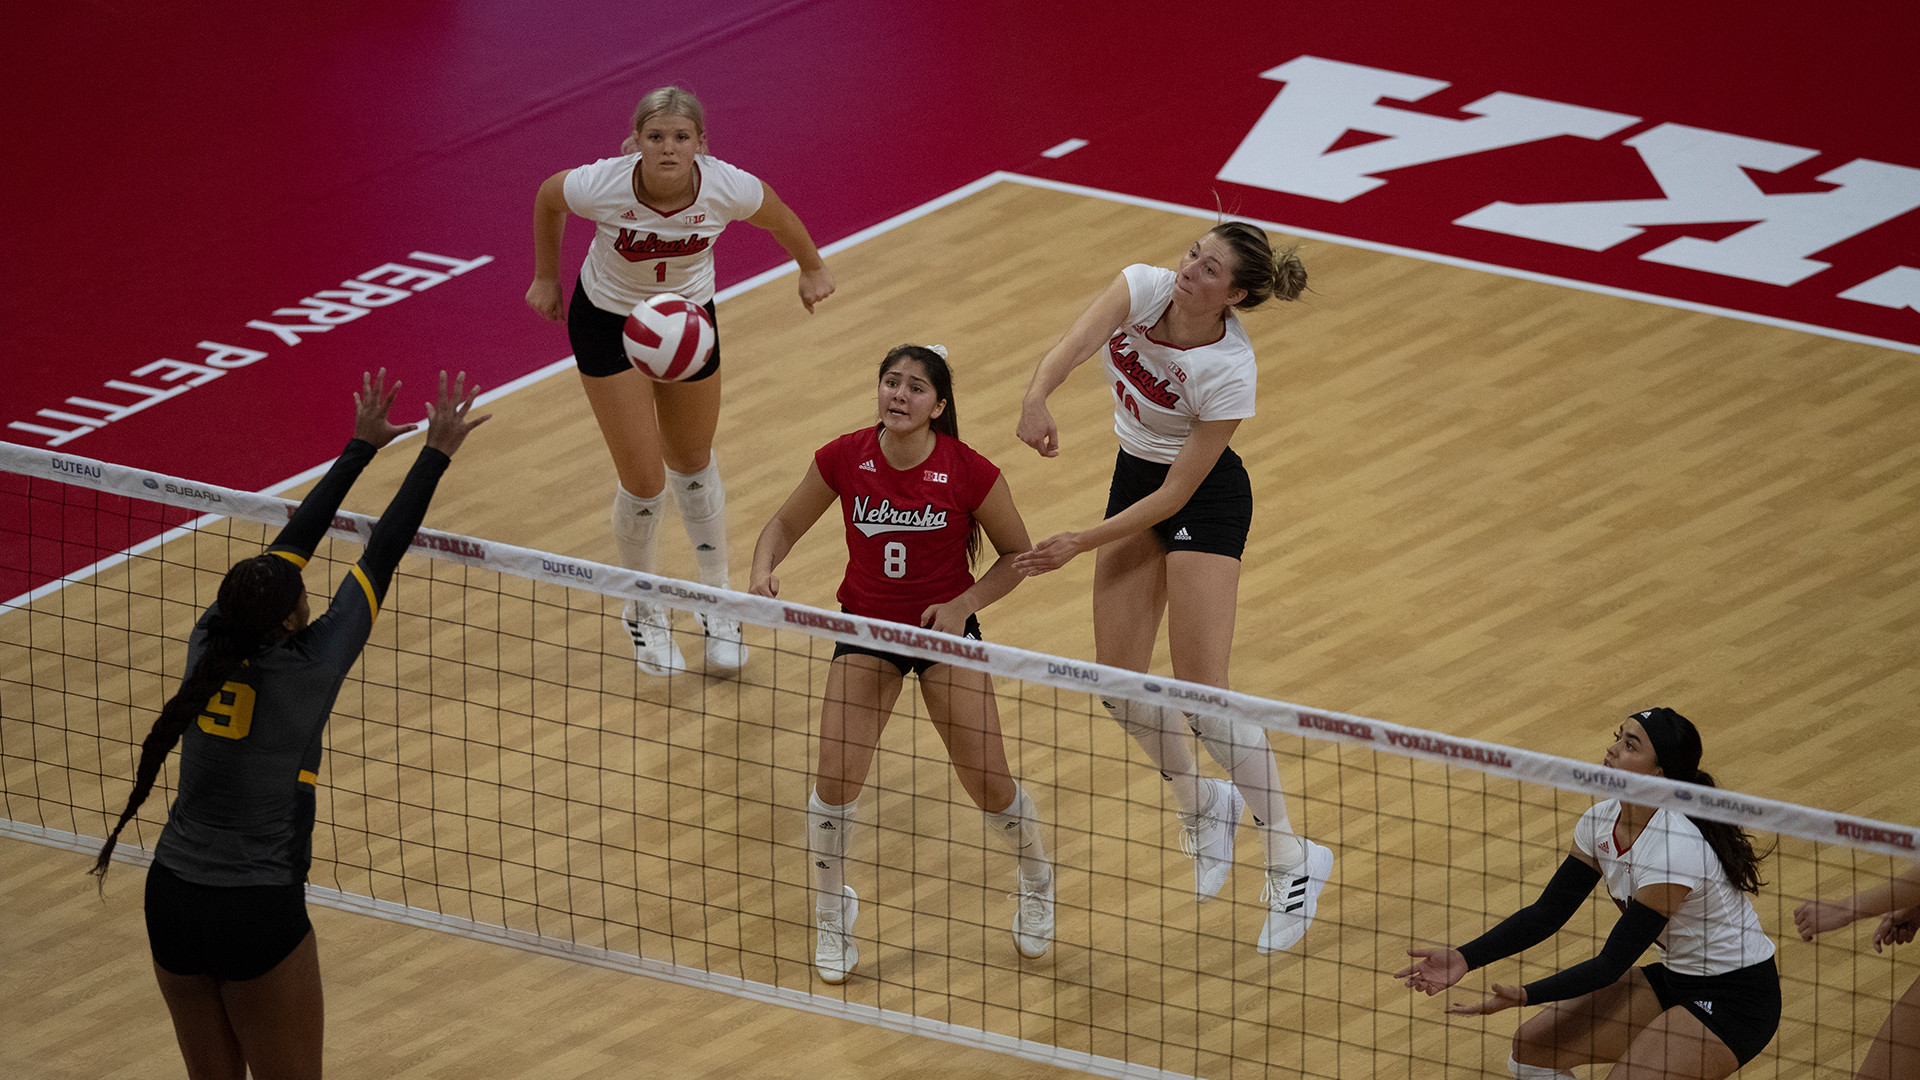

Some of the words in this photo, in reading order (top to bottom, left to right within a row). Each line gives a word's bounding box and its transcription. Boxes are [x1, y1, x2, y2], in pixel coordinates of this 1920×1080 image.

[1215, 54, 1920, 314] KA
[614, 228, 710, 253] Nebraska
[654, 261, 667, 283] 1
[246, 251, 494, 346] TERRY
[1109, 332, 1181, 407] Nebraska
[8, 340, 268, 447] PETTIT
[52, 457, 101, 479] DUTEAU
[165, 483, 222, 503] SUBARU
[852, 494, 948, 527] Nebraska
[542, 559, 593, 580] DUTEAU
[883, 541, 907, 579] 8
[658, 584, 718, 604] SUBARU
[783, 607, 858, 635] HUSKER
[868, 624, 989, 663] VOLLEYBALL
[1048, 662, 1099, 683] DUTEAU
[196, 680, 257, 741] 9
[1168, 687, 1228, 708] SUBARU
[1297, 711, 1375, 741] HUSKER
[1384, 728, 1512, 769] VOLLEYBALL
[1572, 768, 1627, 789] DUTEAU
[1700, 794, 1763, 816] SUBARU
[1834, 819, 1916, 851] HUSKER
